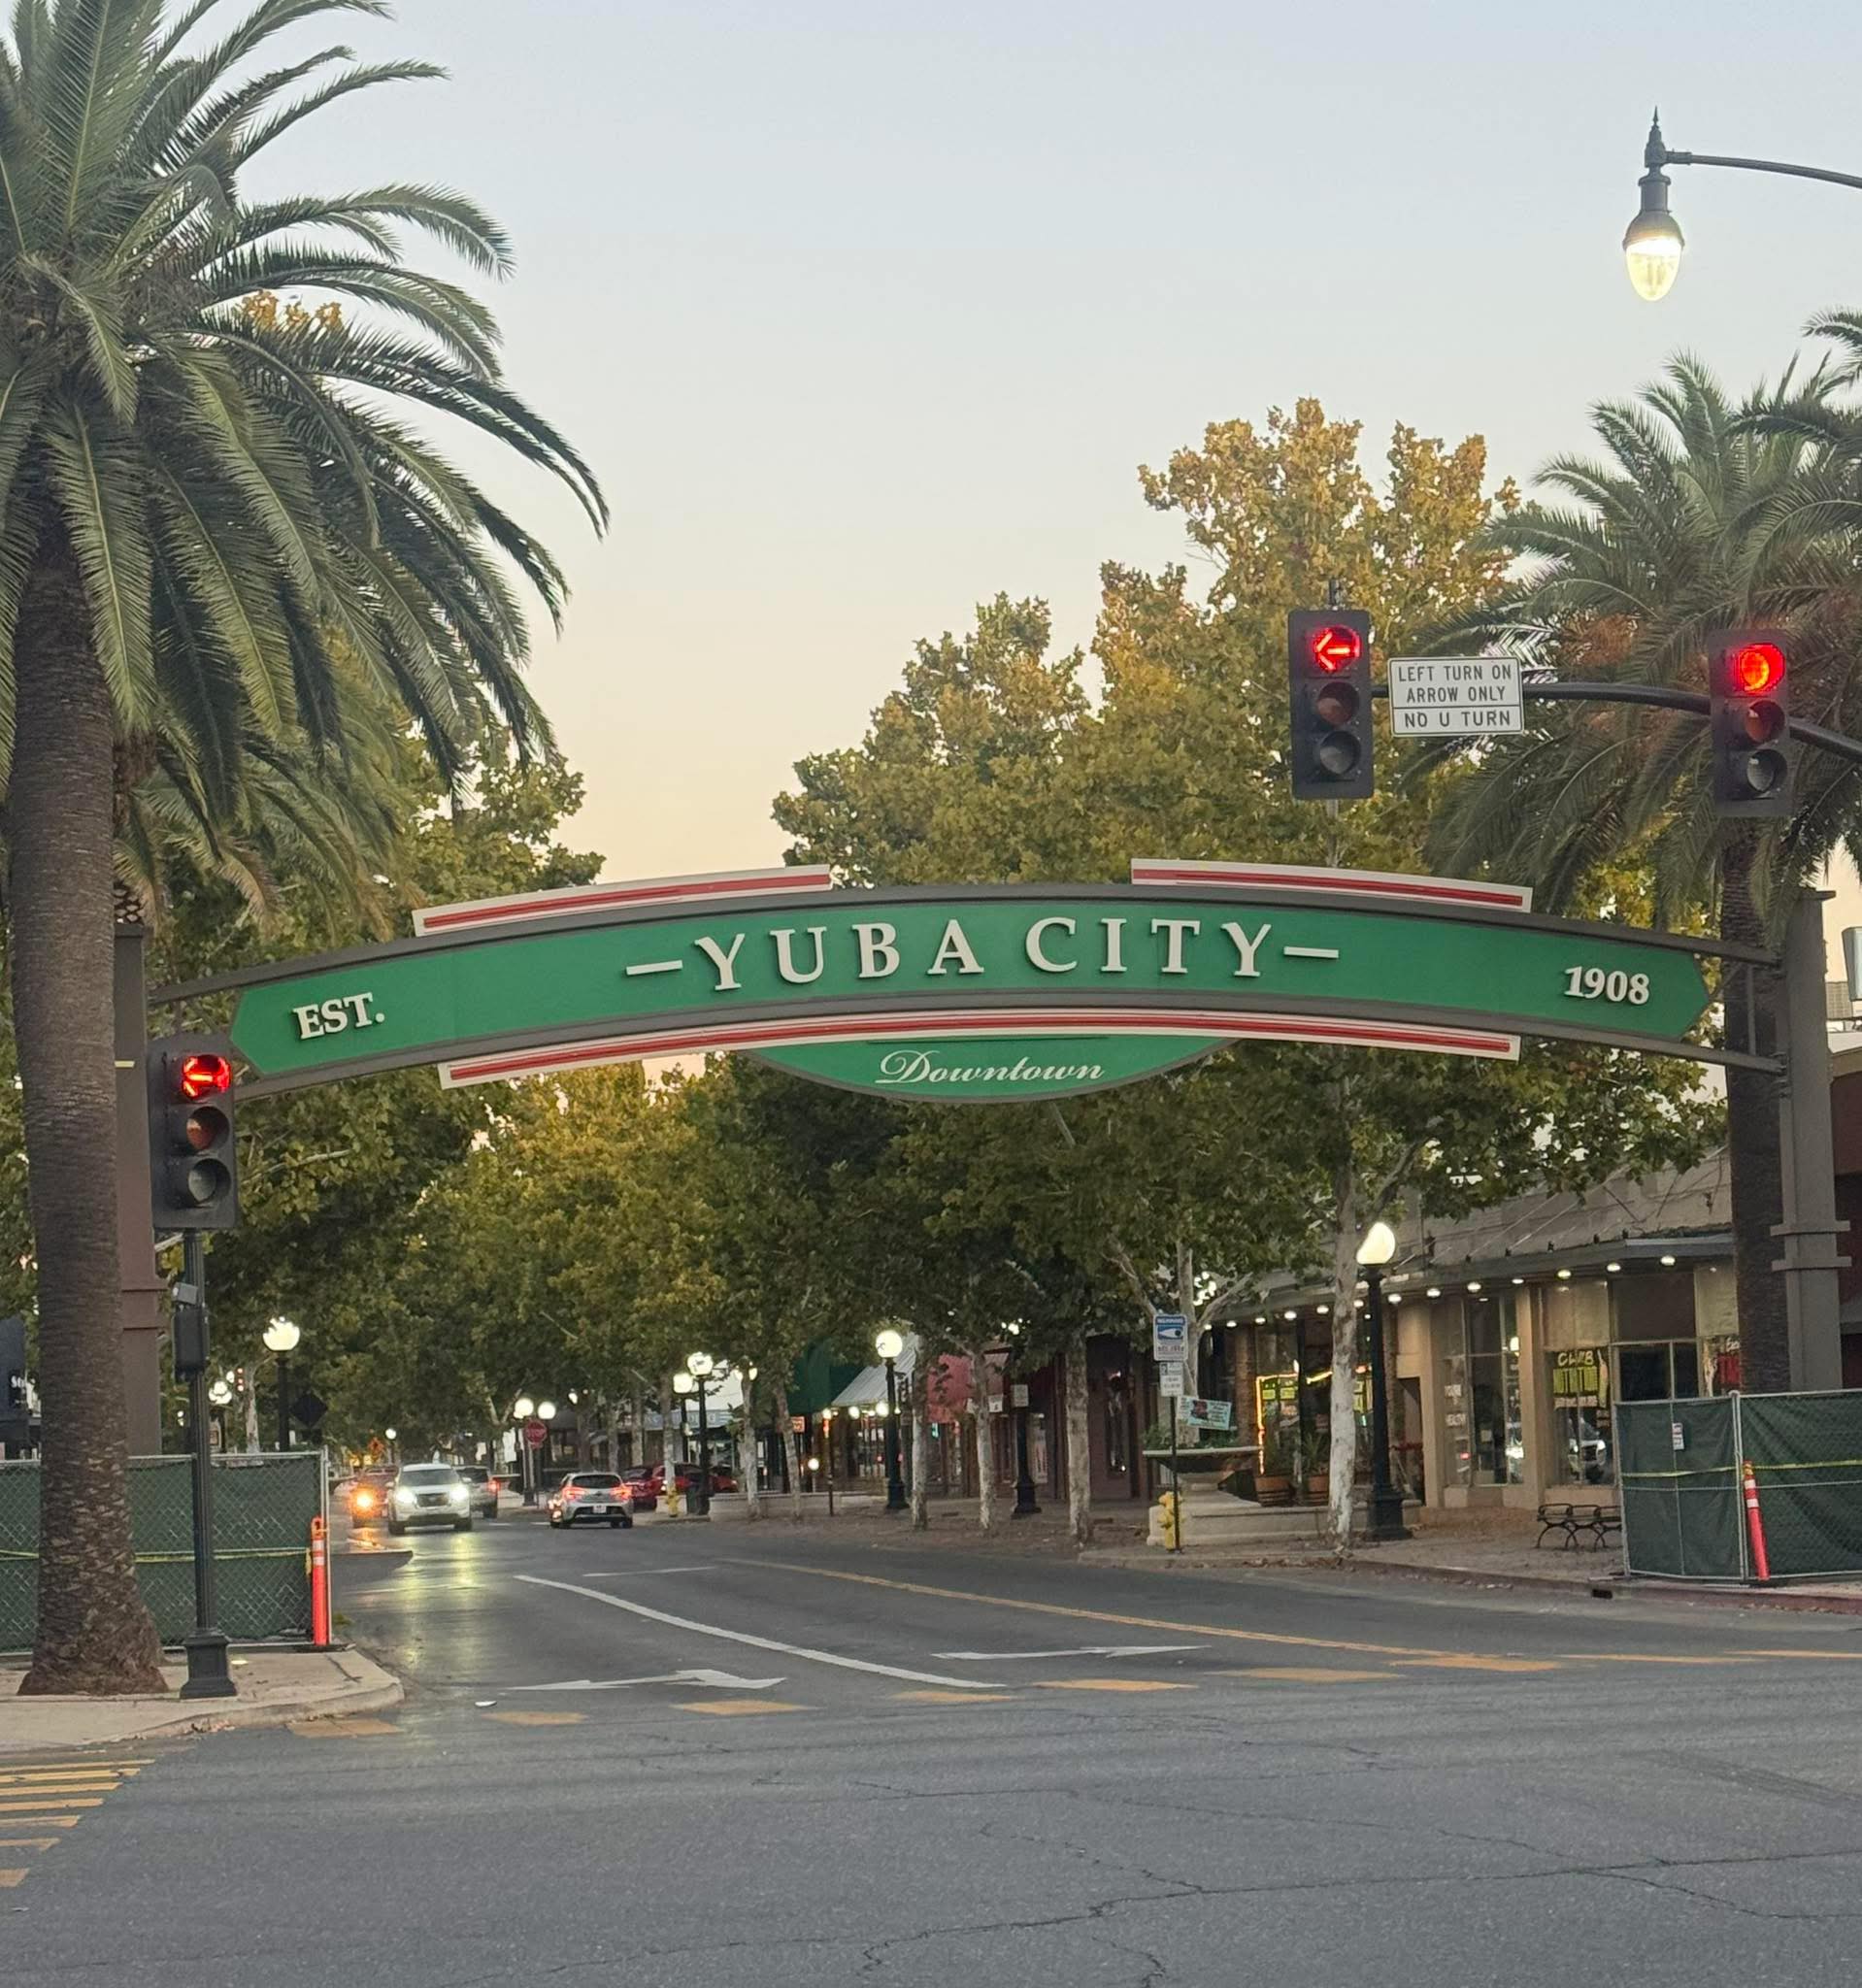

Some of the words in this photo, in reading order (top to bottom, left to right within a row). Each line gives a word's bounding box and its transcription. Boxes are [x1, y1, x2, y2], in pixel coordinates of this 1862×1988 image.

[1398, 666, 1435, 682] LEFT
[1444, 665, 1483, 681] TURN
[1491, 664, 1512, 679] ON
[1407, 686, 1458, 704] ARROW
[1468, 685, 1505, 702] ONLY
[1404, 712, 1428, 728] NO
[1439, 712, 1450, 728] U
[1461, 710, 1511, 727] TURN
[694, 919, 985, 991] YUBA
[1024, 916, 1273, 977] CITY
[1564, 966, 1649, 1005] 1908
[292, 992, 385, 1040] EST.
[875, 1049, 1105, 1084] Downtown
